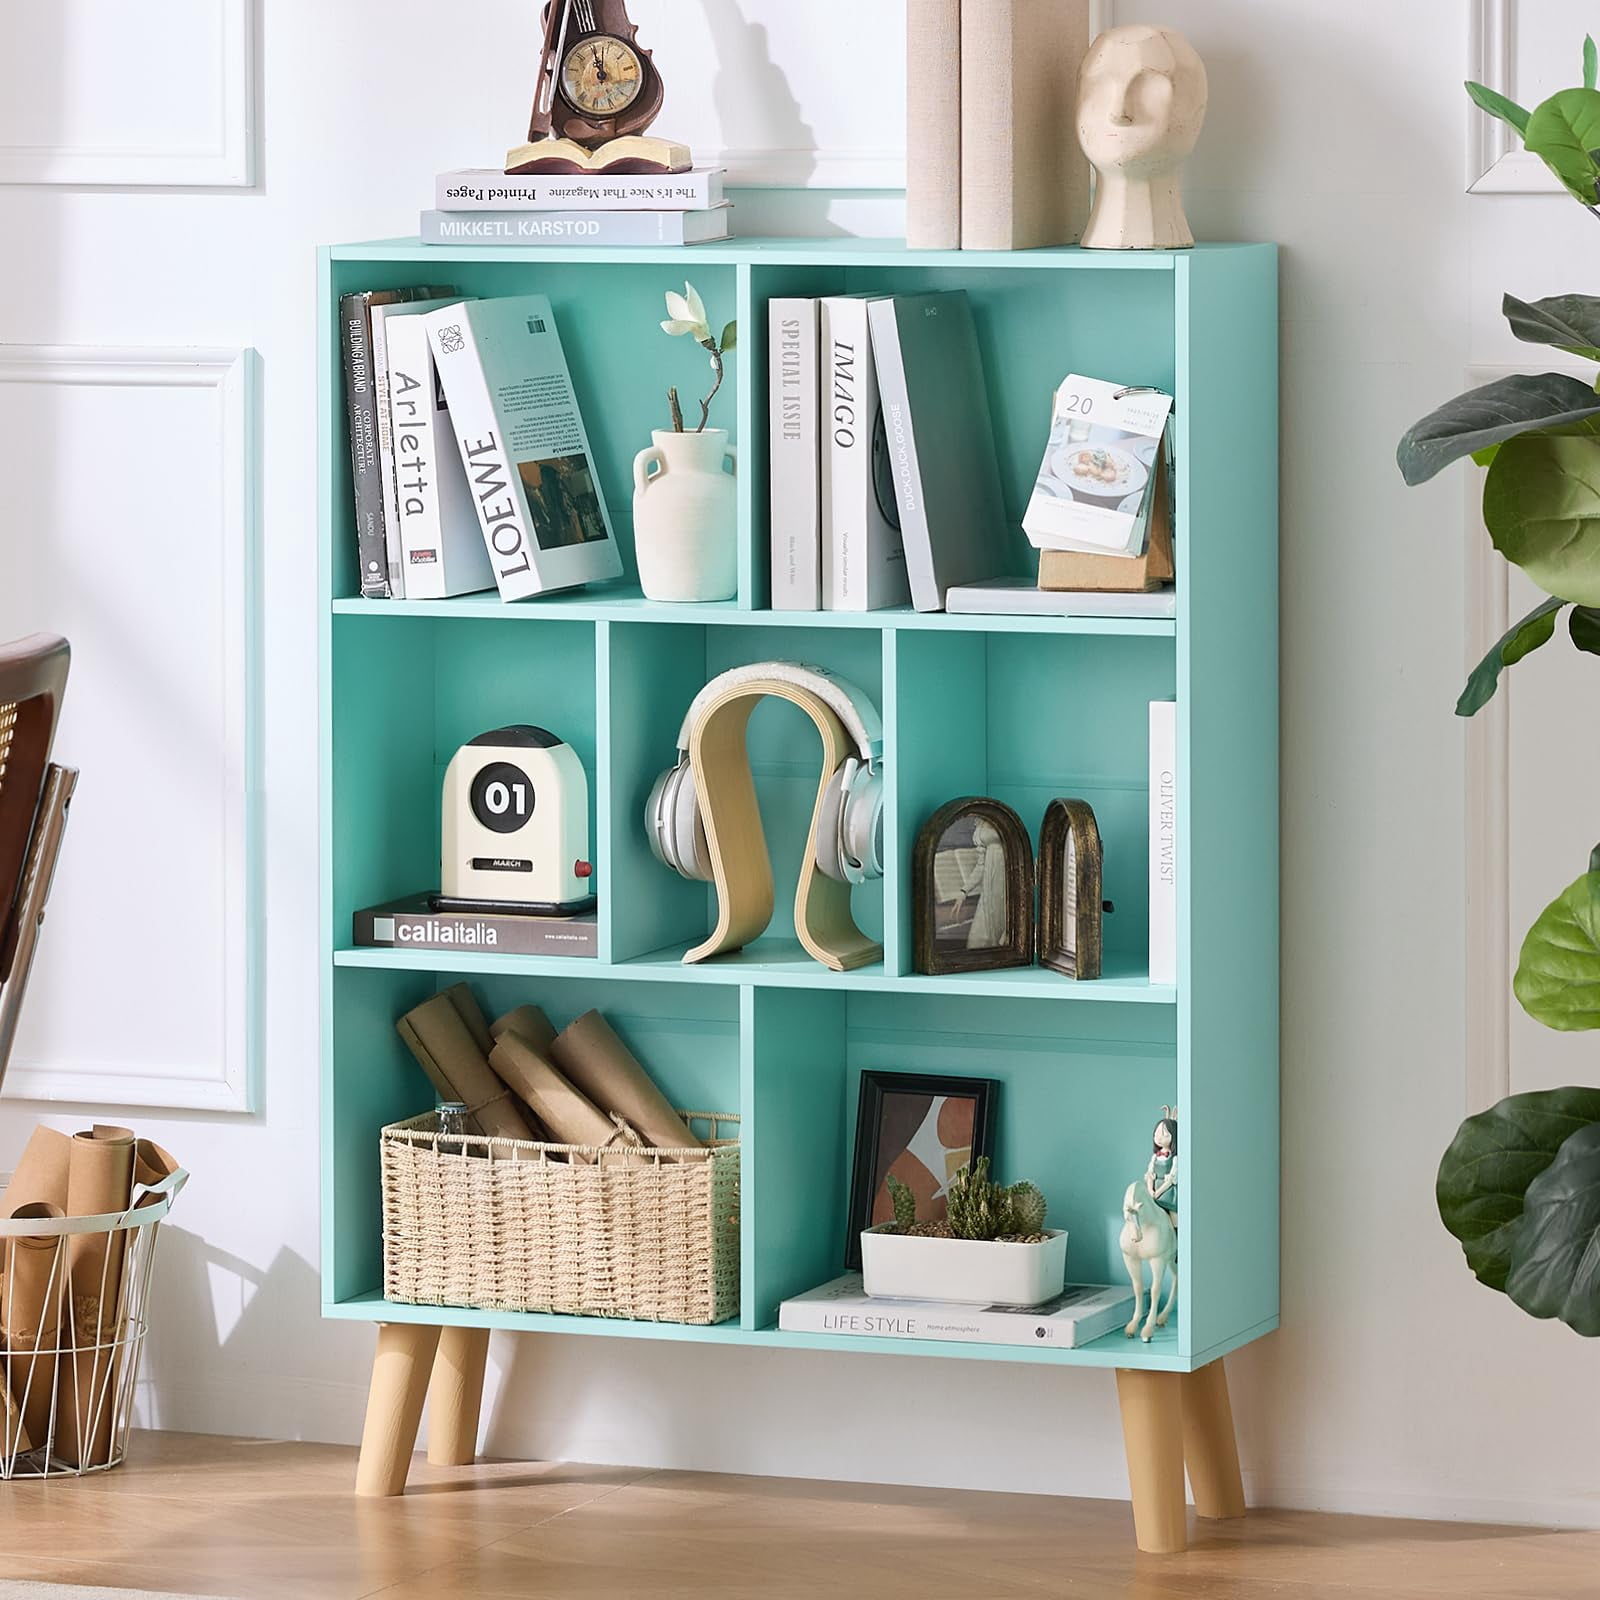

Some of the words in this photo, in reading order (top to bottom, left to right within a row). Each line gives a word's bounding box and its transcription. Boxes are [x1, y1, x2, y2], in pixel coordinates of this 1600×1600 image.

[446, 185, 484, 201] Pages
[488, 186, 537, 201] Printed
[549, 187, 600, 200] Magazine
[603, 188, 628, 199] That
[629, 188, 654, 199] Nice
[656, 188, 674, 199] It's
[678, 188, 697, 199] The
[439, 221, 514, 236] MIKKETL
[518, 220, 601, 236] KARSTOD
[781, 319, 801, 388] SPECIAL
[378, 375, 387, 404] STYLE
[834, 338, 855, 448] IMAGO
[380, 407, 388, 421] AT
[1066, 394, 1093, 415] 20
[783, 396, 801, 440] ISSUE
[353, 403, 367, 475] ARCHITECTURE
[363, 410, 374, 467] CORPORATE
[381, 422, 390, 452] HOME
[395, 371, 428, 516] Arletta
[464, 431, 530, 578] LOEWE
[485, 781, 526, 815] 01
[1160, 770, 1173, 831] OLIVER
[492, 859, 521, 868] MARCH
[1160, 833, 1173, 885] TWIST
[398, 920, 498, 945] caliaitalia
[823, 1314, 859, 1331] LIFE
[864, 1316, 916, 1334] STYLE
[944, 1325, 980, 1333] atmosphere
